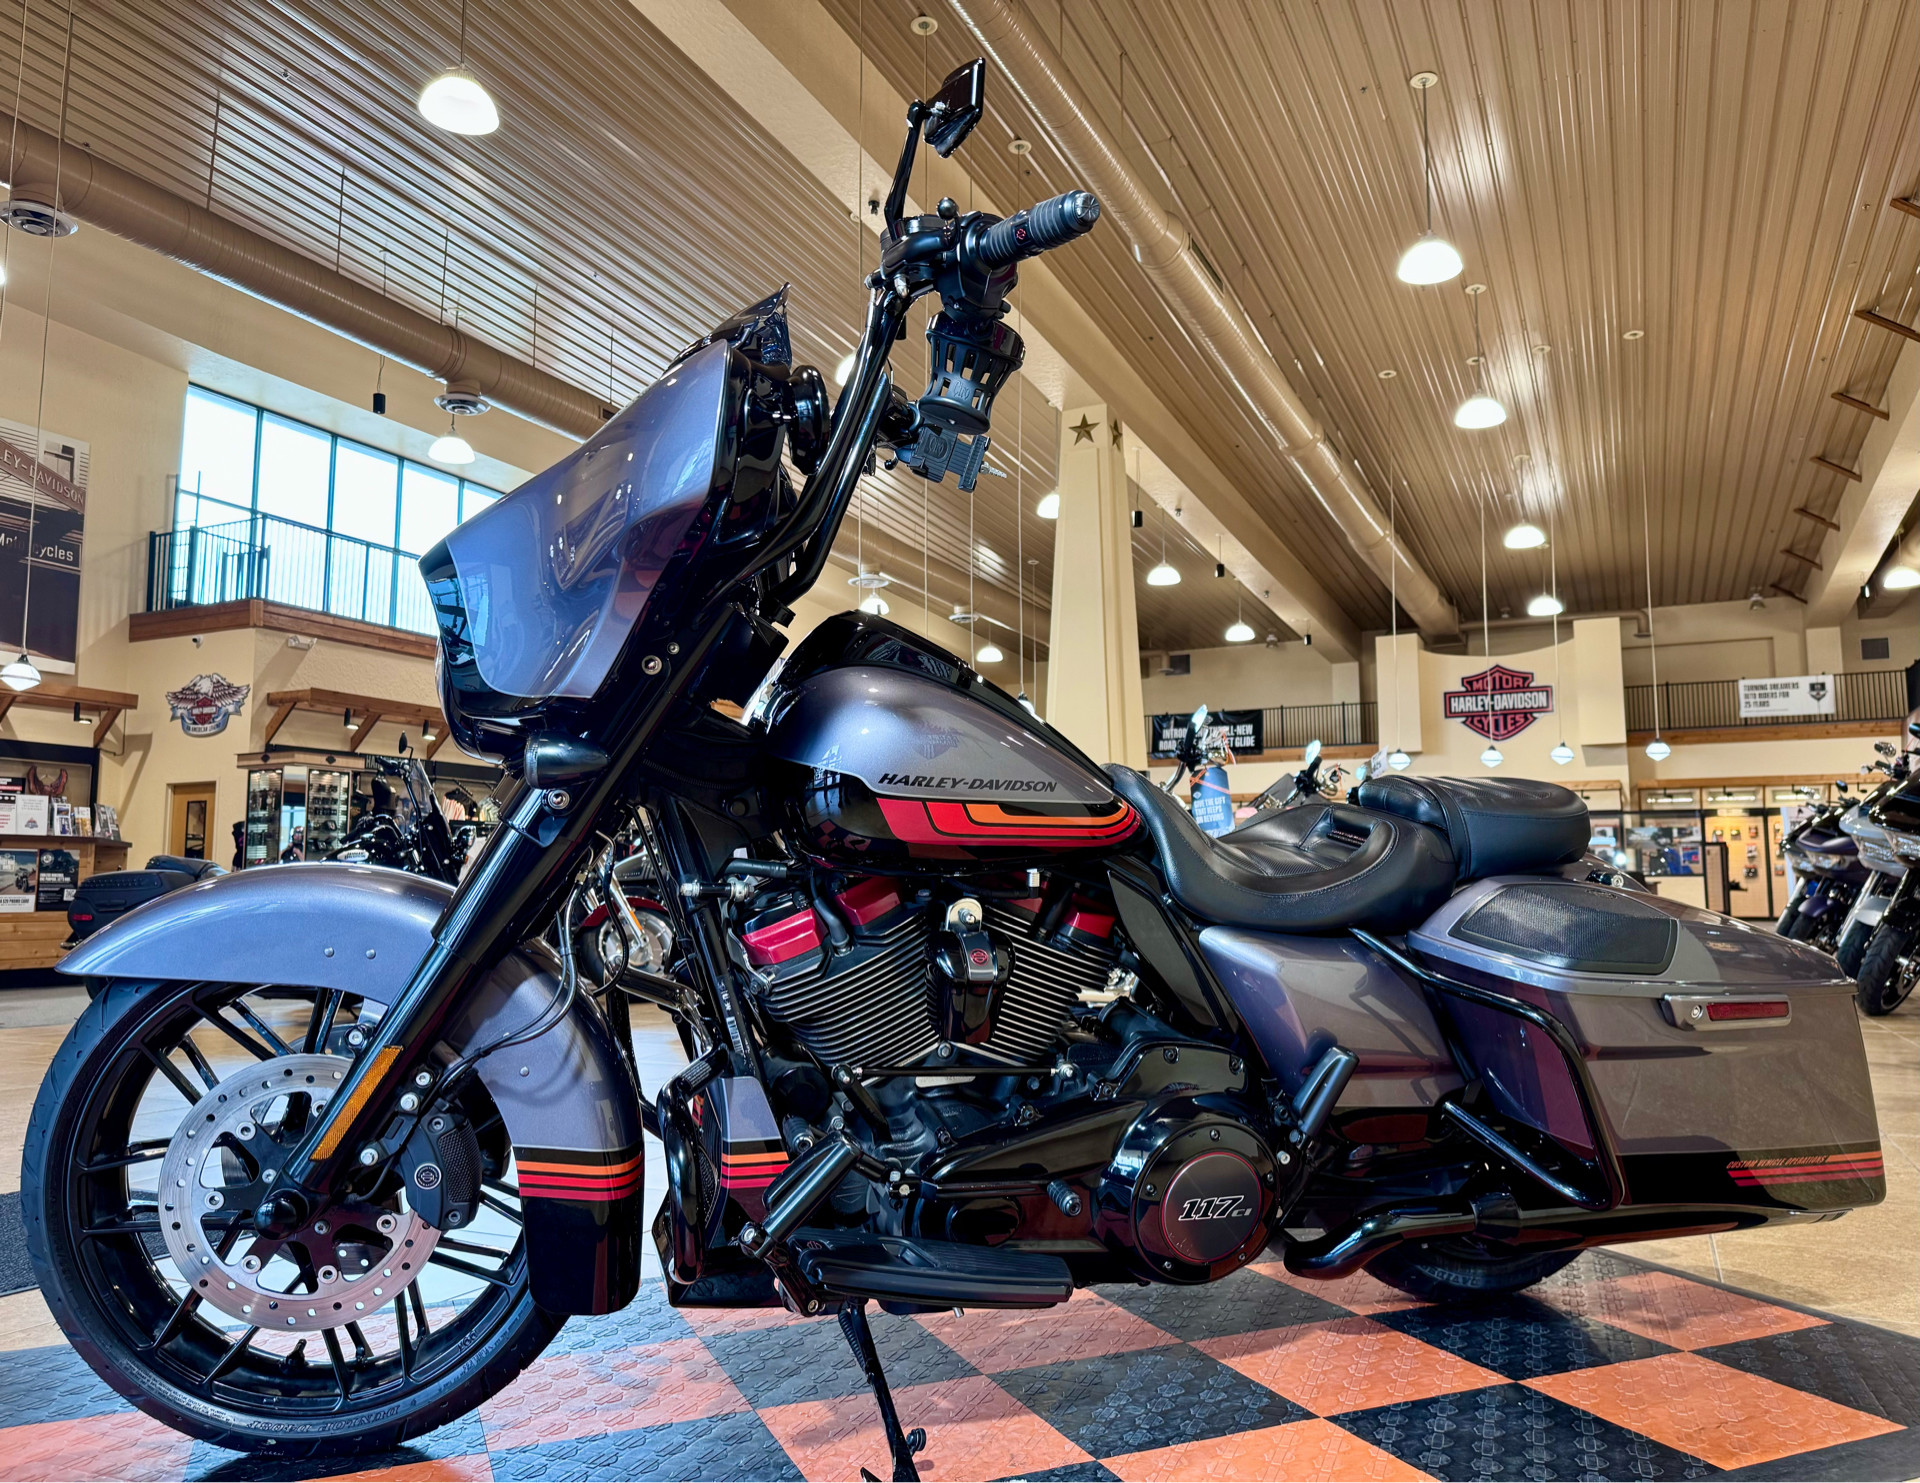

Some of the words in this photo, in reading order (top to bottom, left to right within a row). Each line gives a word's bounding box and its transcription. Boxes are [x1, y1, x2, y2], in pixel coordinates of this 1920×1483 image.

[0, 449, 84, 505] EY-DAVIDSON
[1472, 672, 1524, 692] MOTOR
[1450, 691, 1548, 714] HARLEY-DAVIDSON
[1472, 713, 1526, 736] CYCLES
[1234, 736, 1255, 747] GLIDE
[877, 772, 1058, 793] HARLEY-DAVIDSON
[1726, 1160, 1758, 1169] CUSTOM
[1757, 1158, 1786, 1167] VEHICLE
[1785, 1155, 1828, 1166] OPERATIONS
[1178, 1195, 1245, 1221] 117
